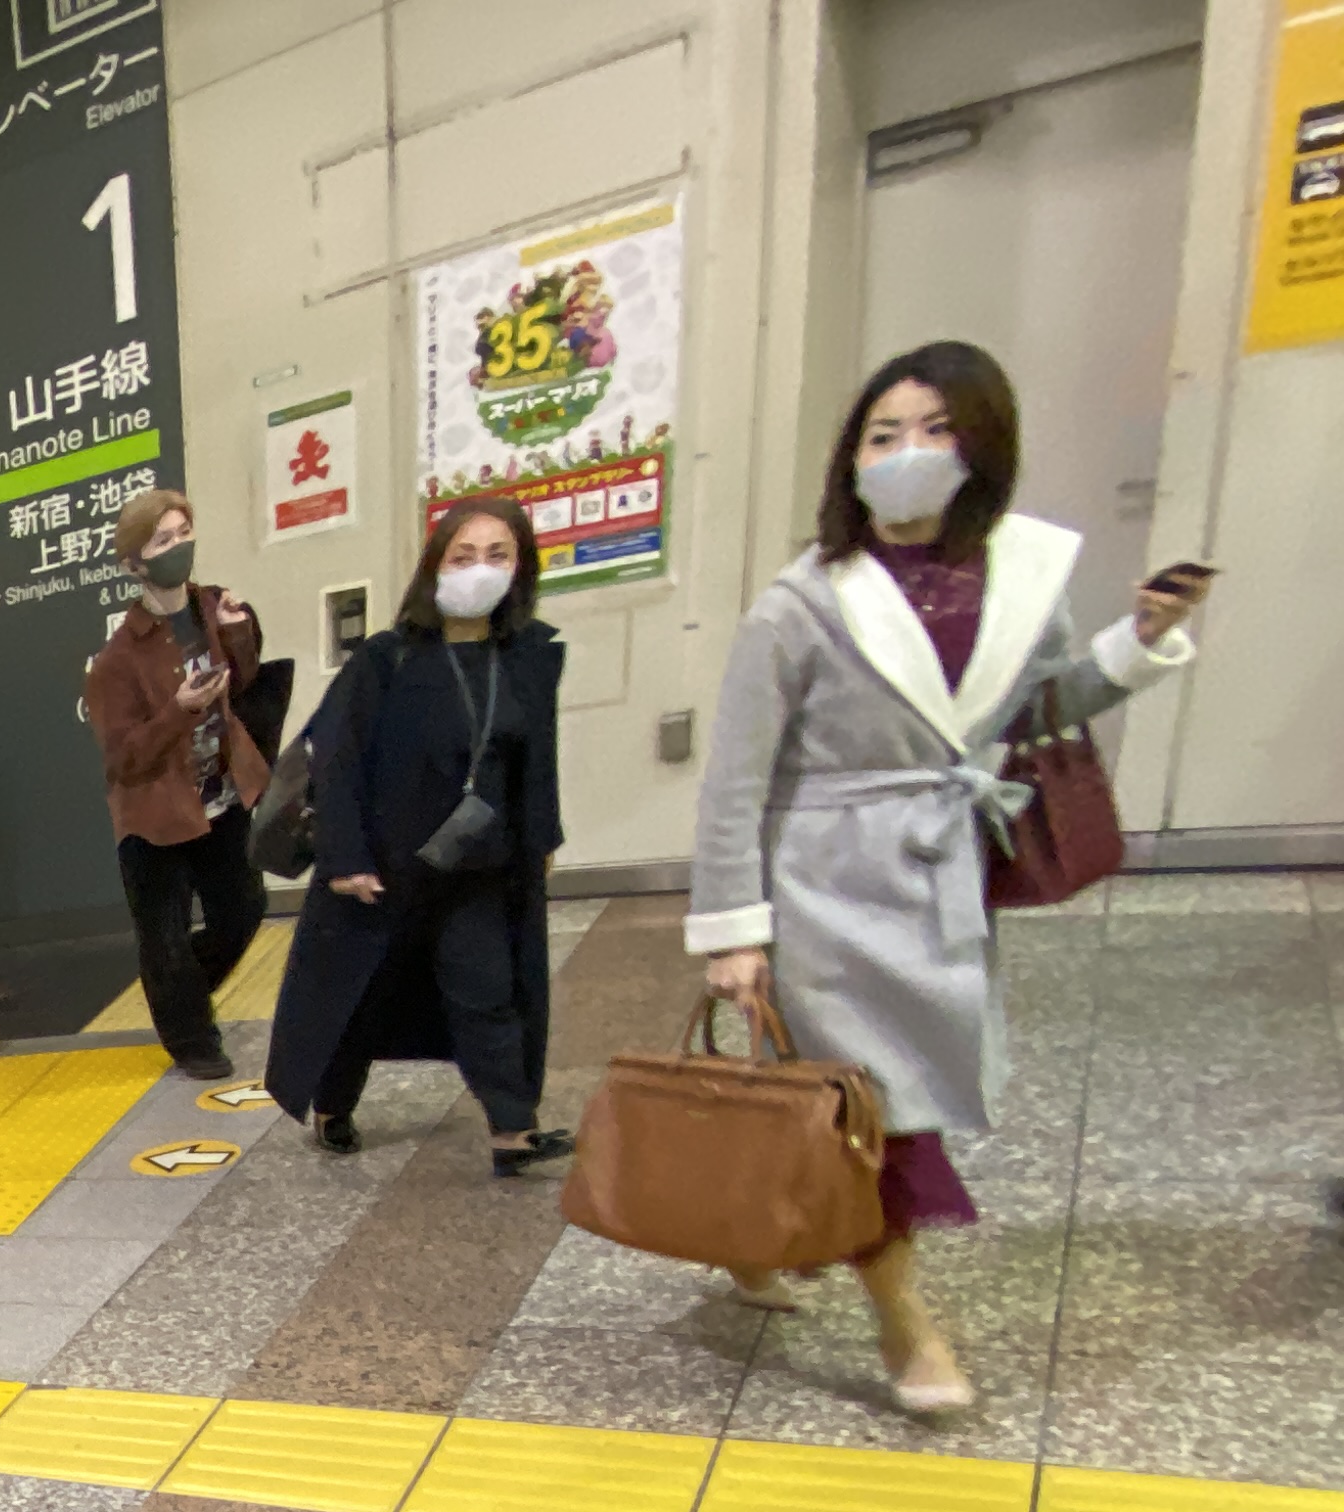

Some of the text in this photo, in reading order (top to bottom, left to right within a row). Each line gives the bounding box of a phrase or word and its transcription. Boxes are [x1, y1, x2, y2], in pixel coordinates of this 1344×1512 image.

[86, 84, 161, 130] Elevator
[81, 172, 138, 323] 1
[9, 340, 152, 431] 山手線
[92, 407, 152, 443] Line
[30, 521, 118, 574] 上野方
[4, 571, 75, 607] Shinjuku,
[79, 562, 123, 587] Ikebu
[99, 586, 111, 606] &
